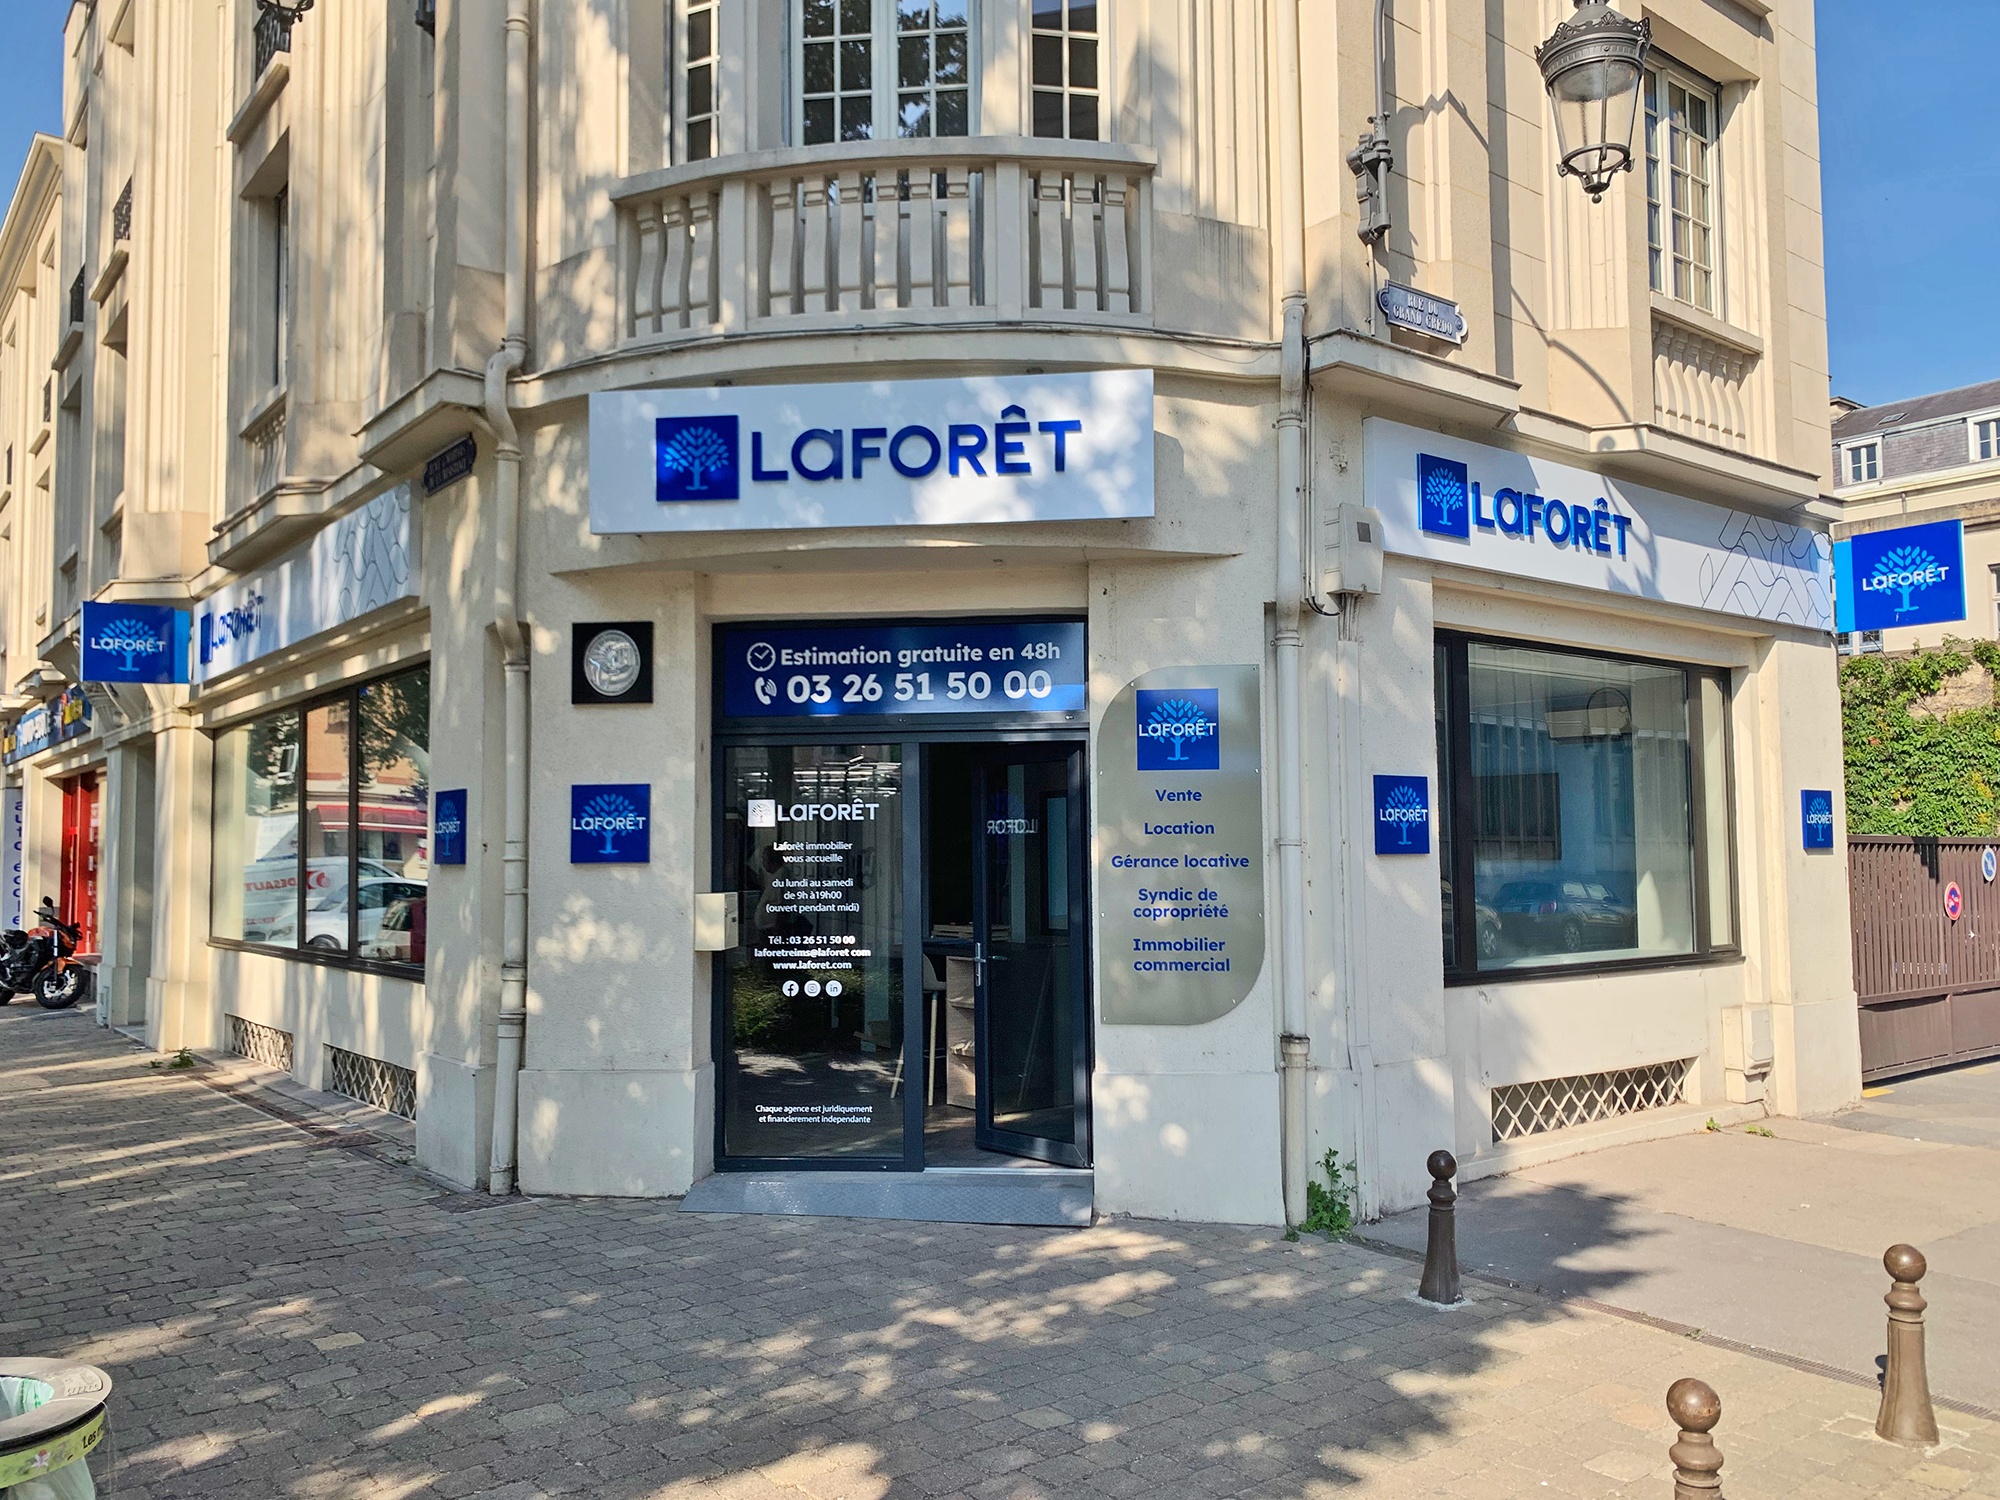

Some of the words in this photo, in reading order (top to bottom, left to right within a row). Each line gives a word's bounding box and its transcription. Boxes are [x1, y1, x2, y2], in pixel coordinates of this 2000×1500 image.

[1407, 294, 1424, 311] RUE
[1428, 301, 1439, 316] DU
[1393, 304, 1422, 325] GRAND
[1425, 315, 1453, 335] CREDO
[781, 645, 891, 665] Estimation
[898, 643, 983, 668] gratuite
[989, 647, 1014, 661] en
[1020, 642, 1060, 660] 48h
[787, 675, 832, 704] 03
[842, 673, 883, 702] 26
[894, 672, 934, 701] 51
[946, 671, 992, 700] 50
[1003, 670, 1051, 699] 00
[1155, 789, 1202, 802] Vente
[1144, 822, 1215, 835] Location
[805, 841, 853, 850] immobilier
[782, 855, 804, 863] vous
[805, 854, 843, 863] accueille
[1111, 853, 1179, 868] Gérance
[1184, 854, 1250, 868] locative
[772, 879, 784, 887] du
[785, 878, 808, 887] lundi
[822, 878, 854, 887] samedi
[783, 891, 796, 900] de
[796, 891, 808, 900] 9h
[1138, 888, 1193, 905] Syndic
[1197, 888, 1218, 901] de
[765, 903, 798, 914] (ouvert
[798, 903, 836, 914] pendant
[837, 902, 860, 913] midi)
[1133, 904, 1229, 922] copropriété
[802, 935, 815, 944] 26
[815, 935, 827, 944] 51
[829, 935, 842, 944] 50
[842, 935, 856, 944] 00
[1133, 938, 1226, 952] Immobilier
[772, 960, 852, 970] www.laforet.com
[1133, 958, 1231, 972] commercial
[755, 1105, 783, 1114] Chaque
[783, 1106, 810, 1114] agence
[810, 1105, 821, 1113] est
[758, 1115, 767, 1123] et
[83, 1431, 96, 1449] Les
